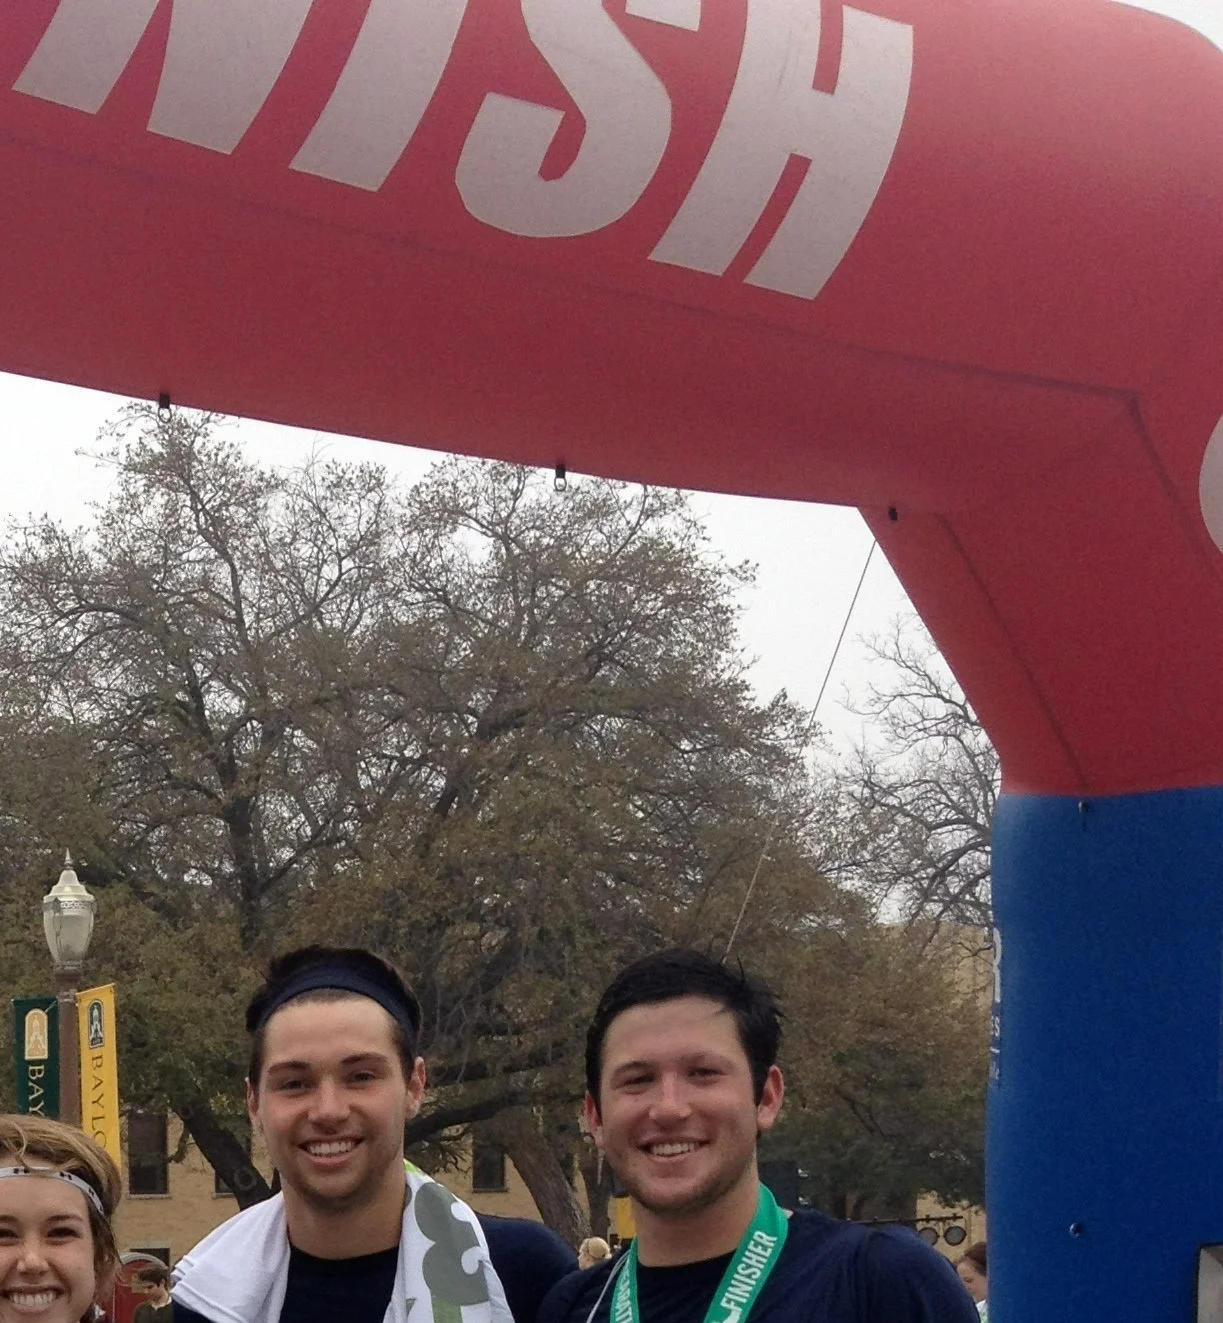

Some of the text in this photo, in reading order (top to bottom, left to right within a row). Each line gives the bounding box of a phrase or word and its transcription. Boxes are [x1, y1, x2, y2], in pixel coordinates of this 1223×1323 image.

[28, 1064, 45, 1117] BAY
[91, 1054, 106, 1148] BAYLO
[721, 1230, 778, 1312] FINISHER
